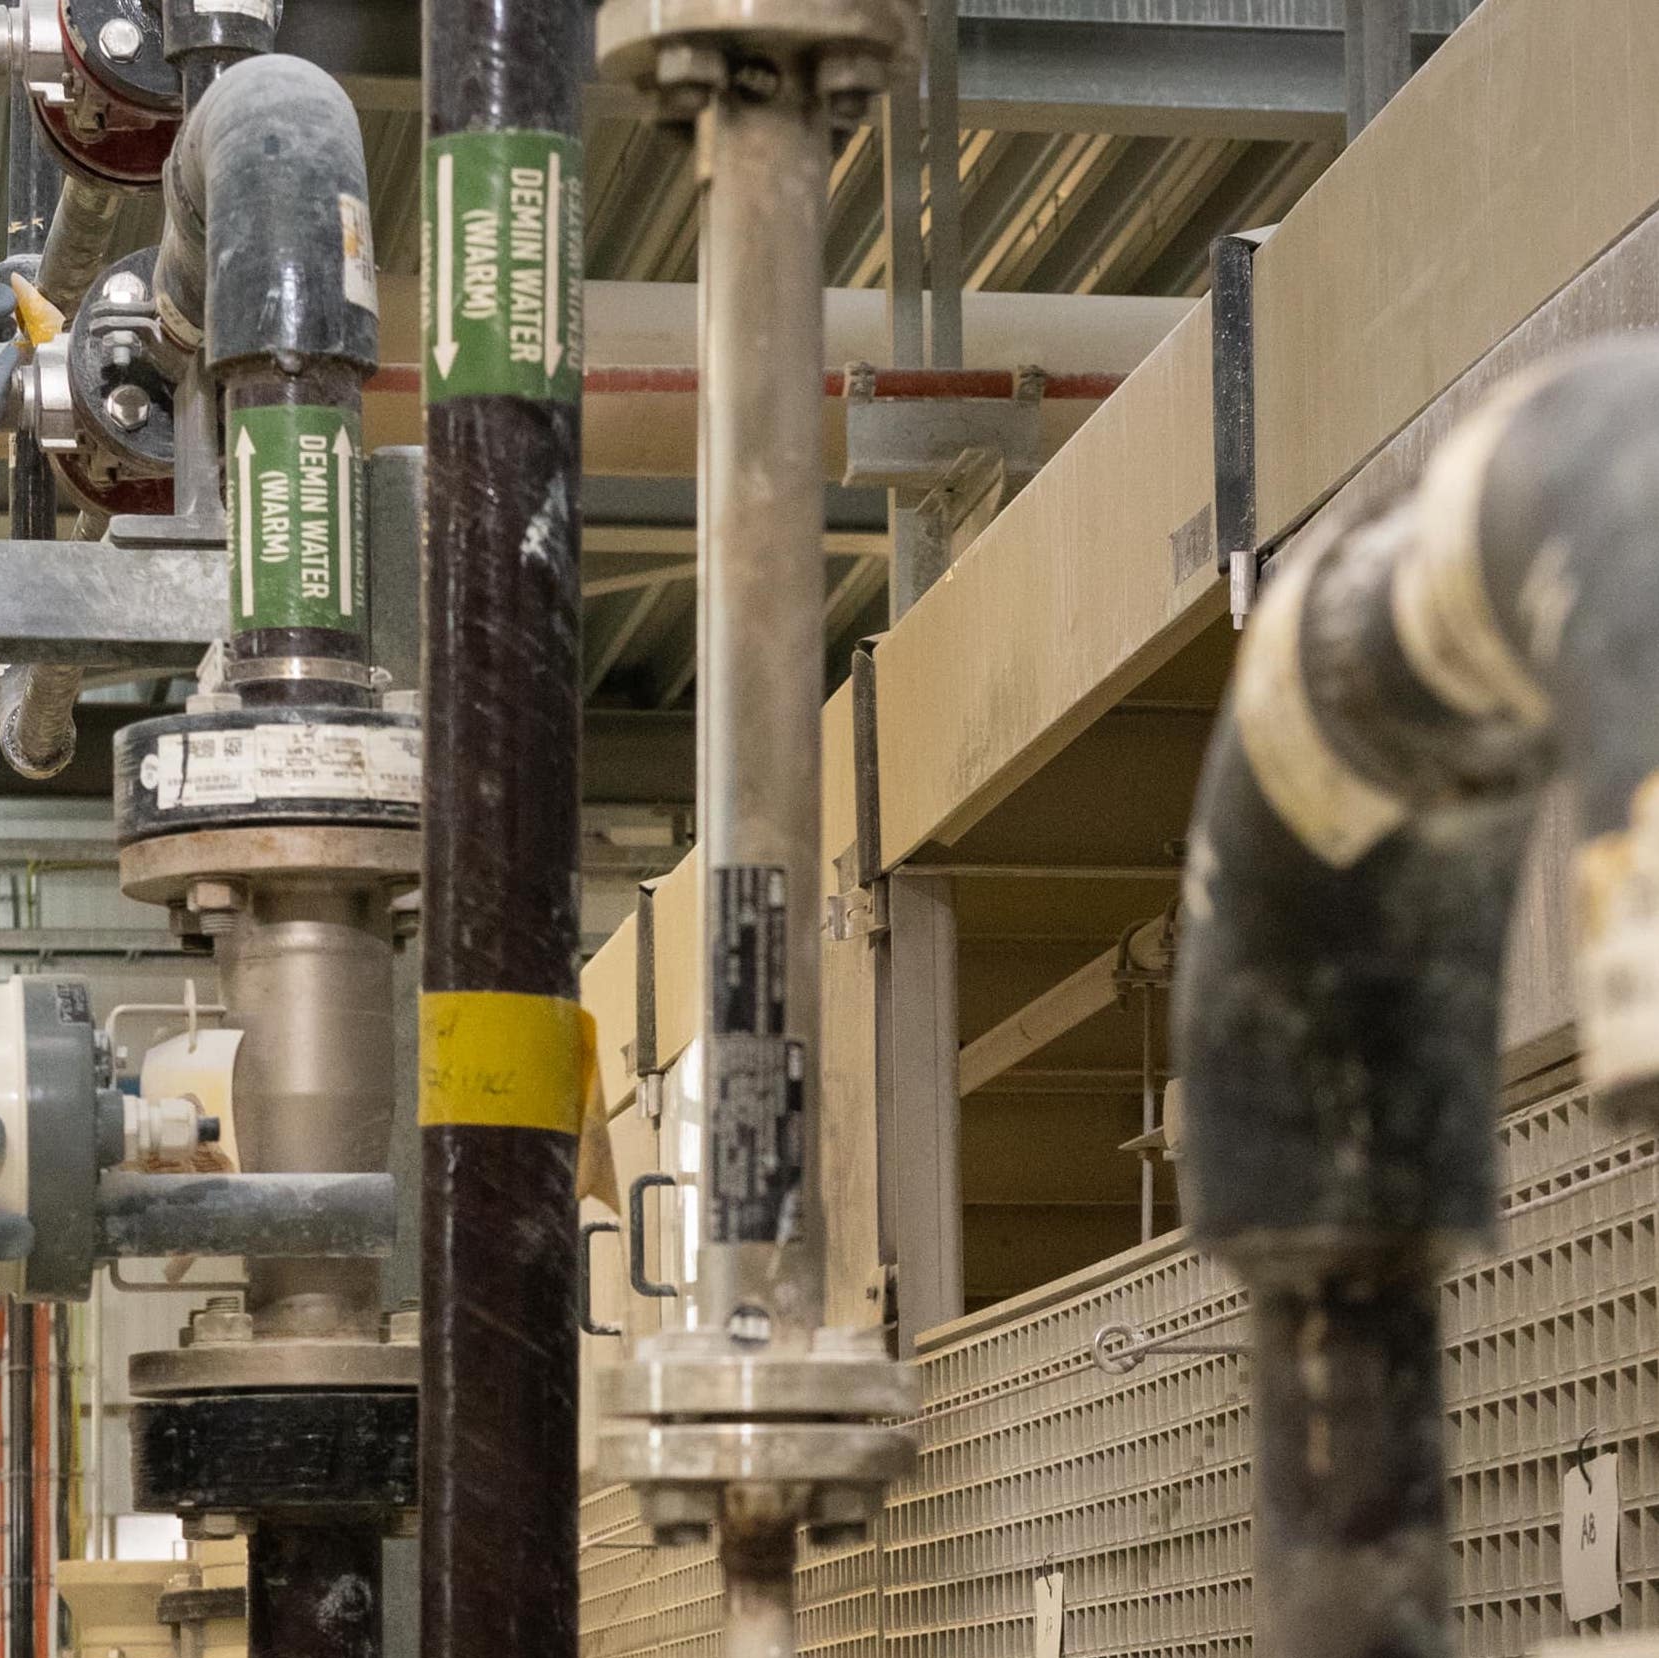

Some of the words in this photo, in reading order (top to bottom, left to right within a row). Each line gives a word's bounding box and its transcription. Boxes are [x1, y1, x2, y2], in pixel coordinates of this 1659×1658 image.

[510, 168, 544, 260] DEMIN
[461, 208, 498, 320] (WARM)
[509, 268, 543, 363] WATER
[258, 470, 290, 563] (WARM)
[299, 434, 329, 513] DEMIN
[300, 519, 330, 598] WATER
